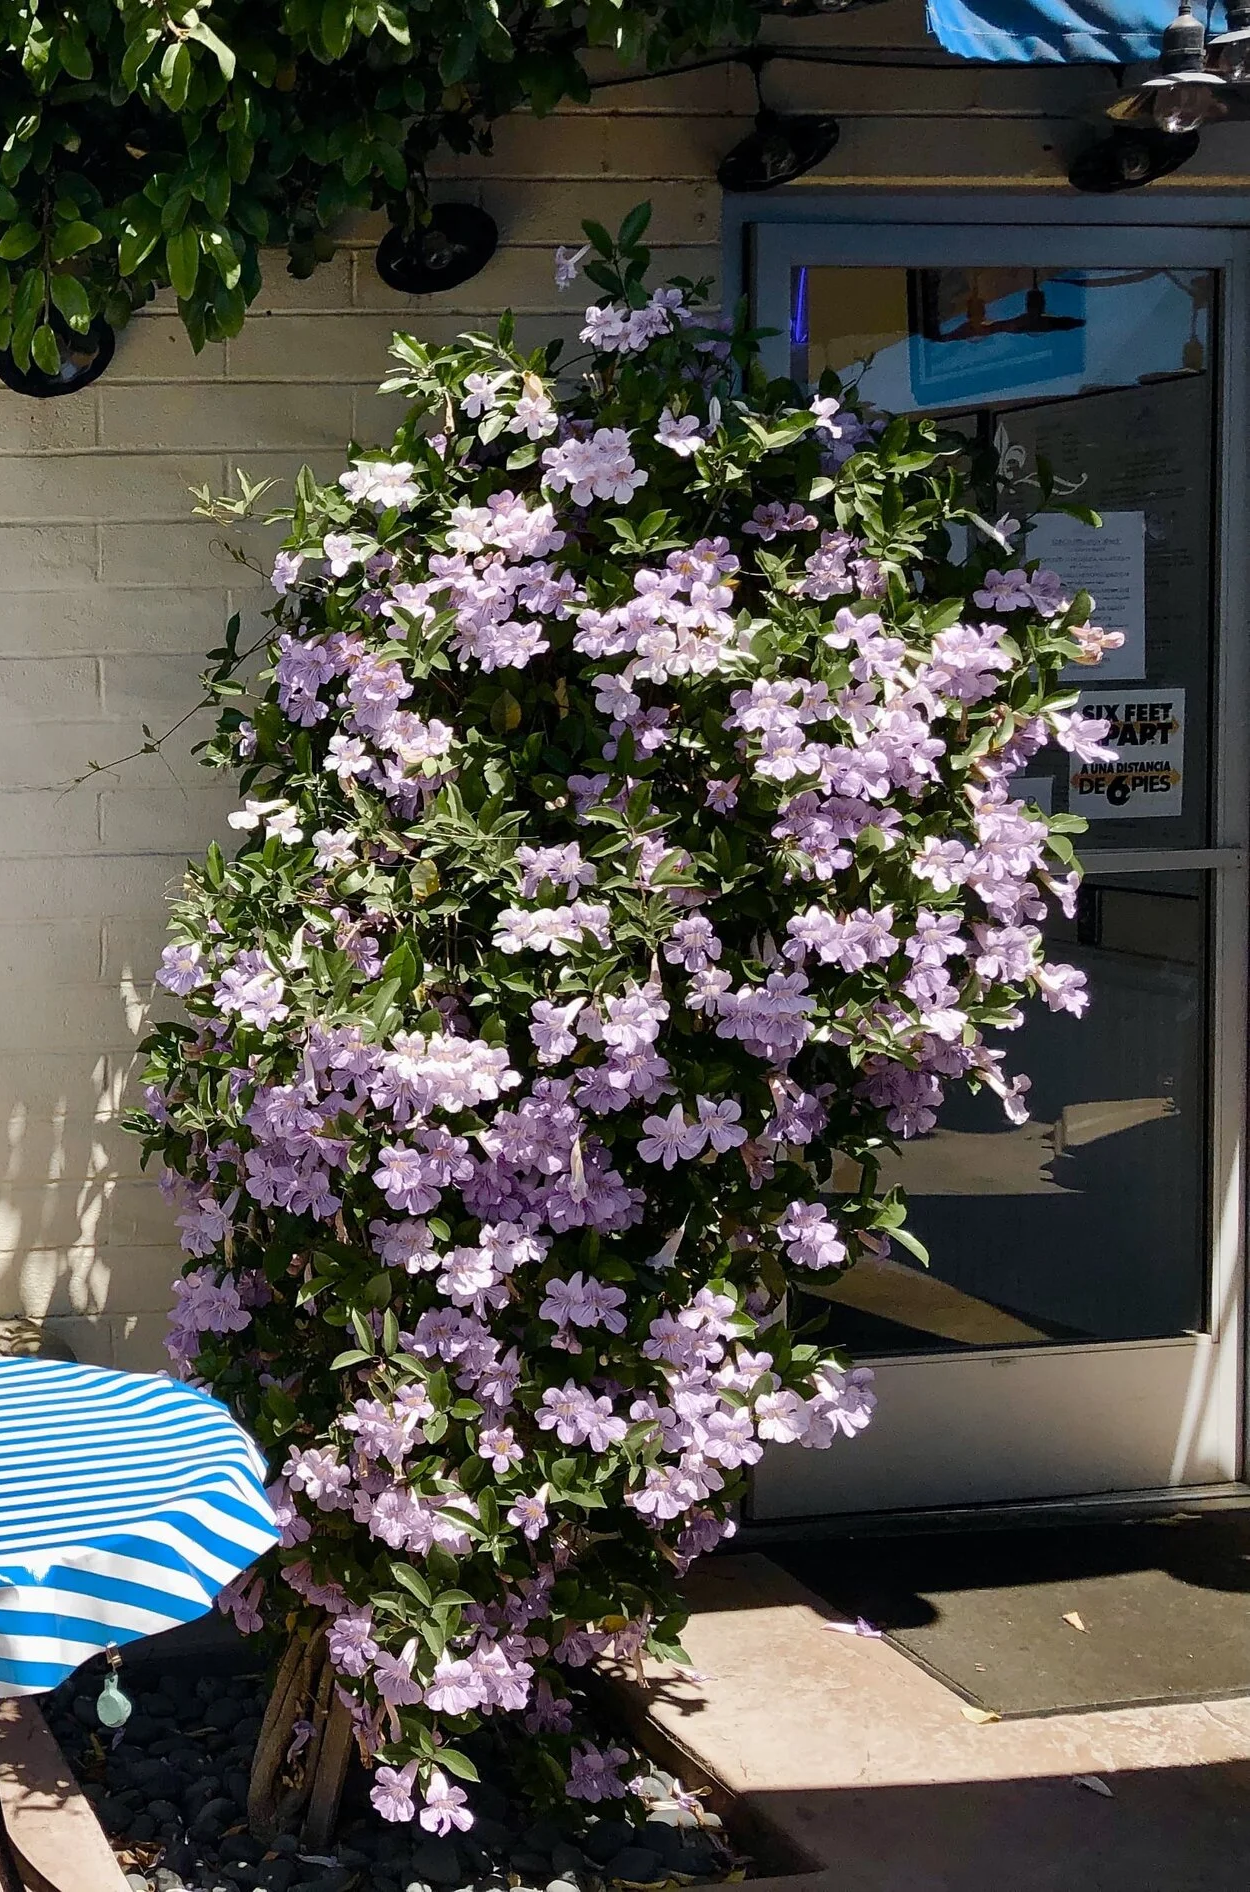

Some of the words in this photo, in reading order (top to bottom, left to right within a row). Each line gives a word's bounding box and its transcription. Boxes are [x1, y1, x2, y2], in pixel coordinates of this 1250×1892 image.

[1082, 704, 1120, 720] SIX
[1124, 702, 1173, 722] FEET
[1095, 722, 1173, 746] PART
[1080, 764, 1089, 774] A
[1090, 762, 1114, 774] UNA
[1116, 761, 1171, 773] DISTANCIA
[1079, 777, 1106, 795] DE
[1106, 776, 1130, 806] 6
[1131, 775, 1171, 792] PIES
